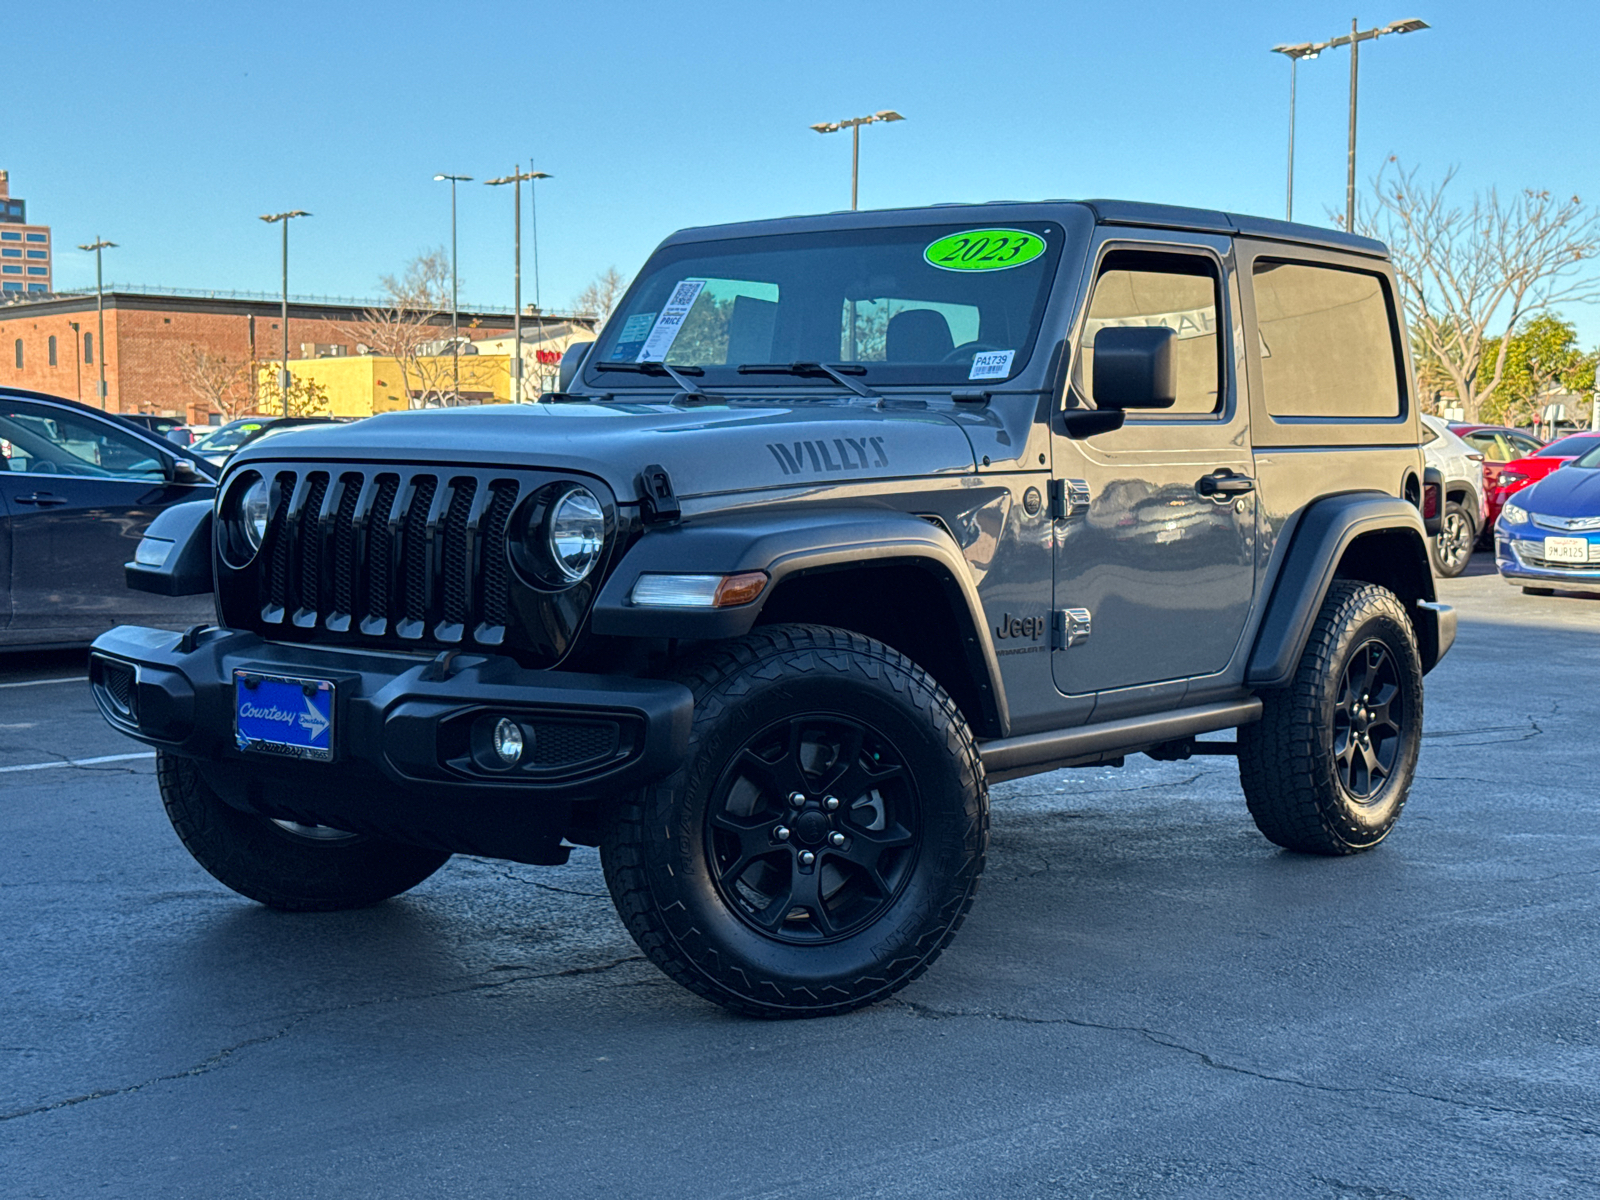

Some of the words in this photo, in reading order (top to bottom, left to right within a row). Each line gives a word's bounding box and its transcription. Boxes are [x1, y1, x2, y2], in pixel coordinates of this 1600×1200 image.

[938, 237, 1030, 262] 2023
[659, 316, 682, 325] PRICE
[975, 354, 1008, 366] PA1739
[766, 436, 889, 475] WILLYS
[996, 612, 1046, 641] Jeep
[240, 702, 297, 727] Courtesy
